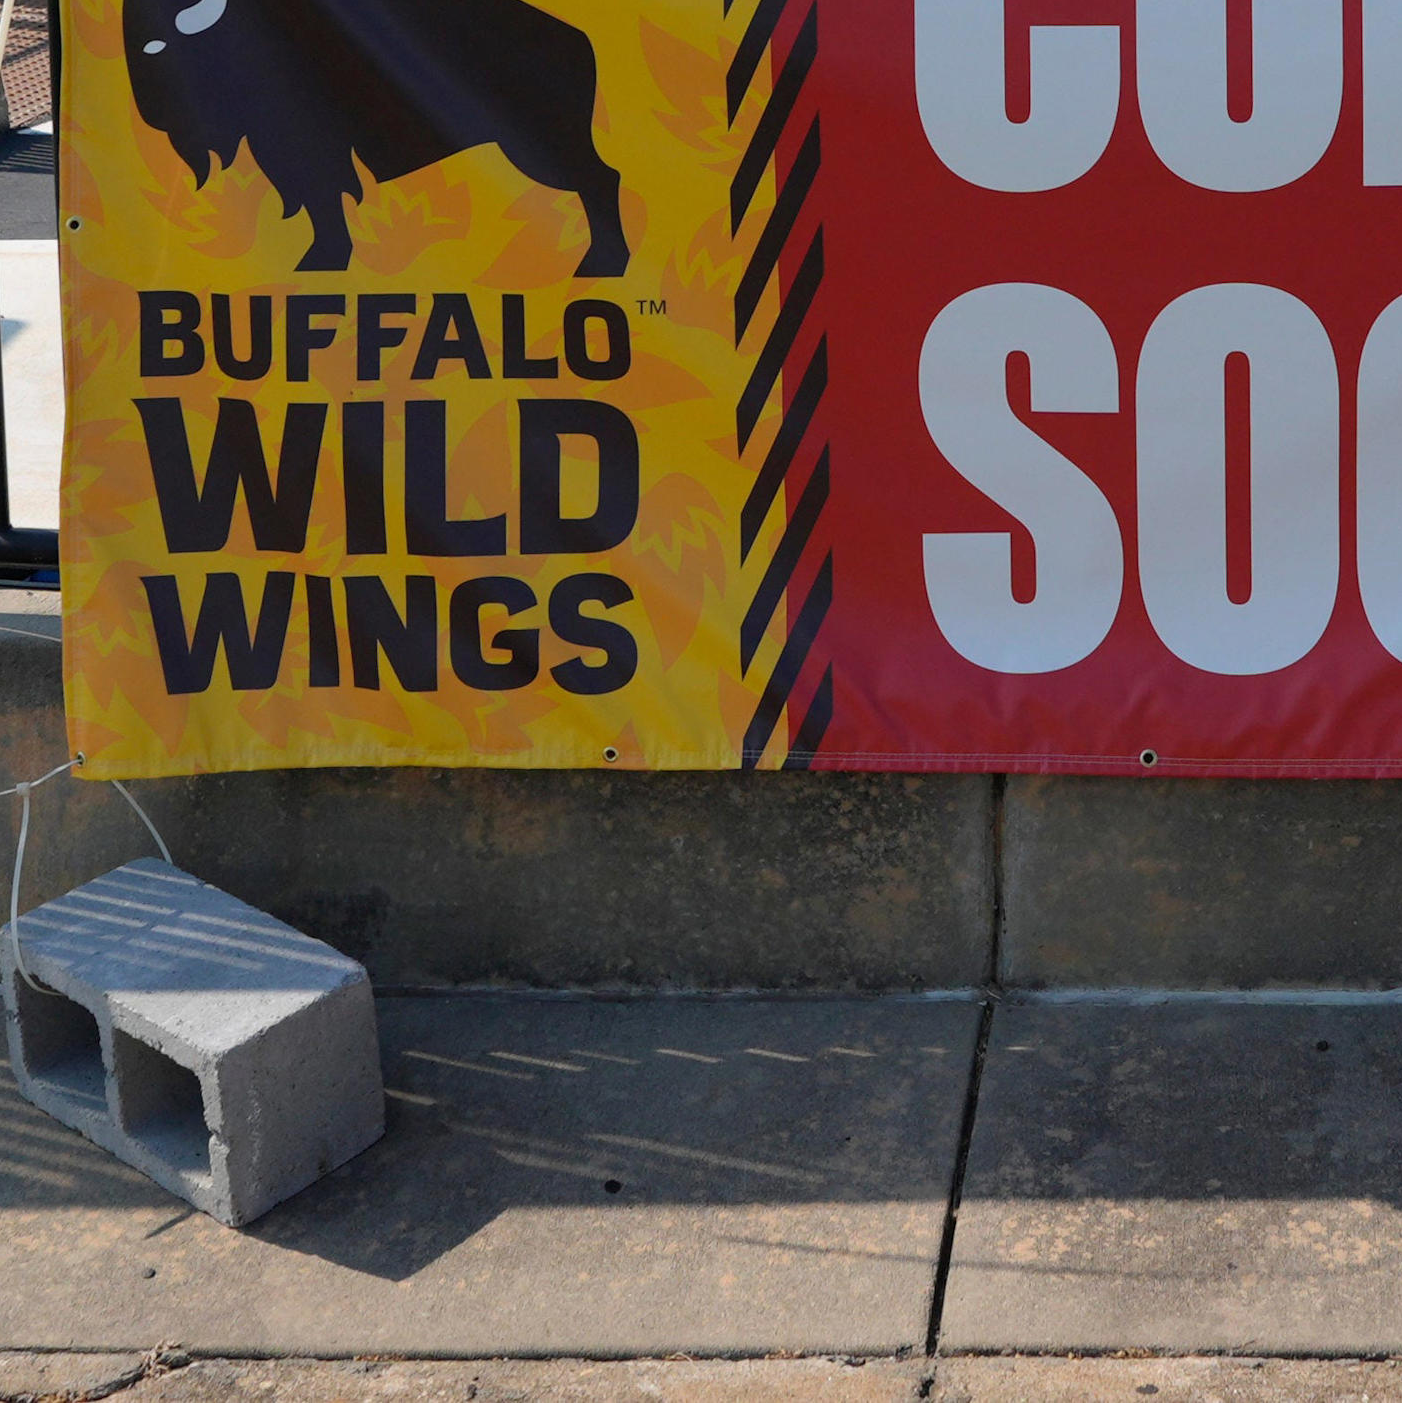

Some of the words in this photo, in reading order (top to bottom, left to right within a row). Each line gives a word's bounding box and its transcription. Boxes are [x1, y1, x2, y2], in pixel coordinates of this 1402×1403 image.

[136, 290, 632, 382] BUFFALO
[131, 397, 640, 557] WILD
[137, 570, 639, 695] WINGS
